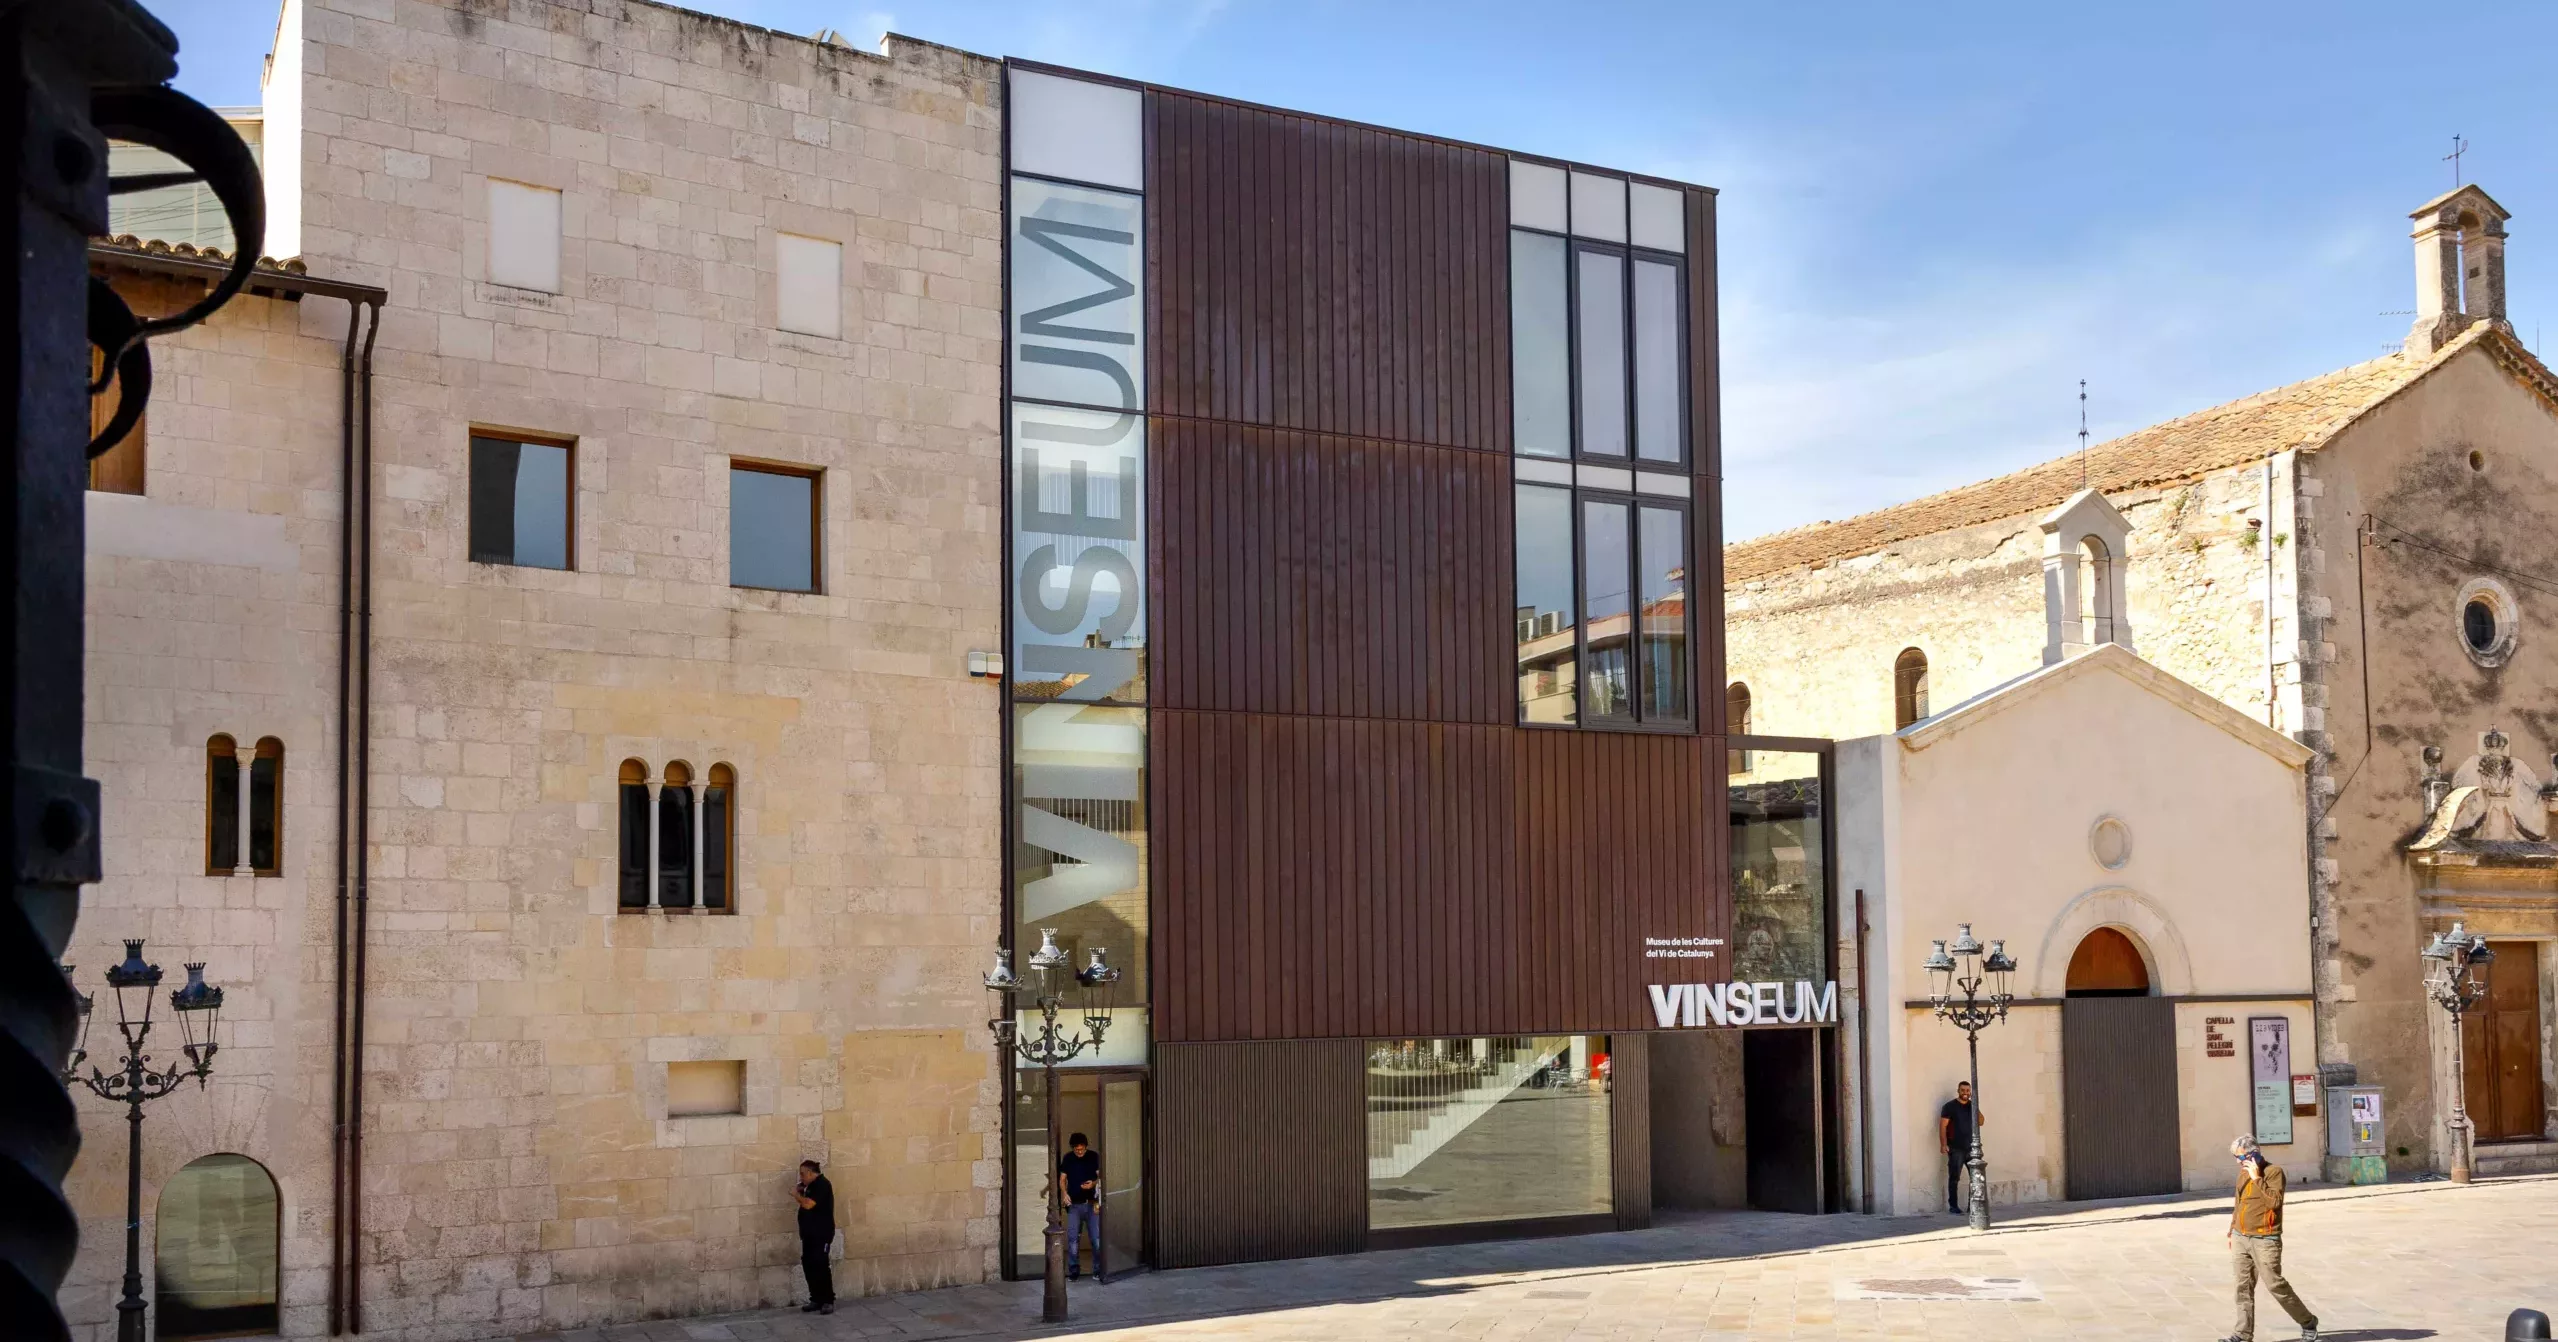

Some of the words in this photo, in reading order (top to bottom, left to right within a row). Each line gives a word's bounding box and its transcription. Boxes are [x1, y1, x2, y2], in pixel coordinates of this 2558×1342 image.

[1019, 215, 1138, 926] VINSEUM
[1646, 937, 1670, 946] Museu
[1671, 937, 1681, 946] de
[1681, 937, 1693, 946] les
[1693, 937, 1724, 946] Cultures
[1658, 949, 1667, 958] Vi
[1667, 949, 1677, 958] de
[1677, 949, 1714, 959] Catalunya
[1648, 981, 1837, 1027] VINSEUM
[2206, 1025, 2215, 1033] DE
[2206, 1033, 2224, 1041] SANT
